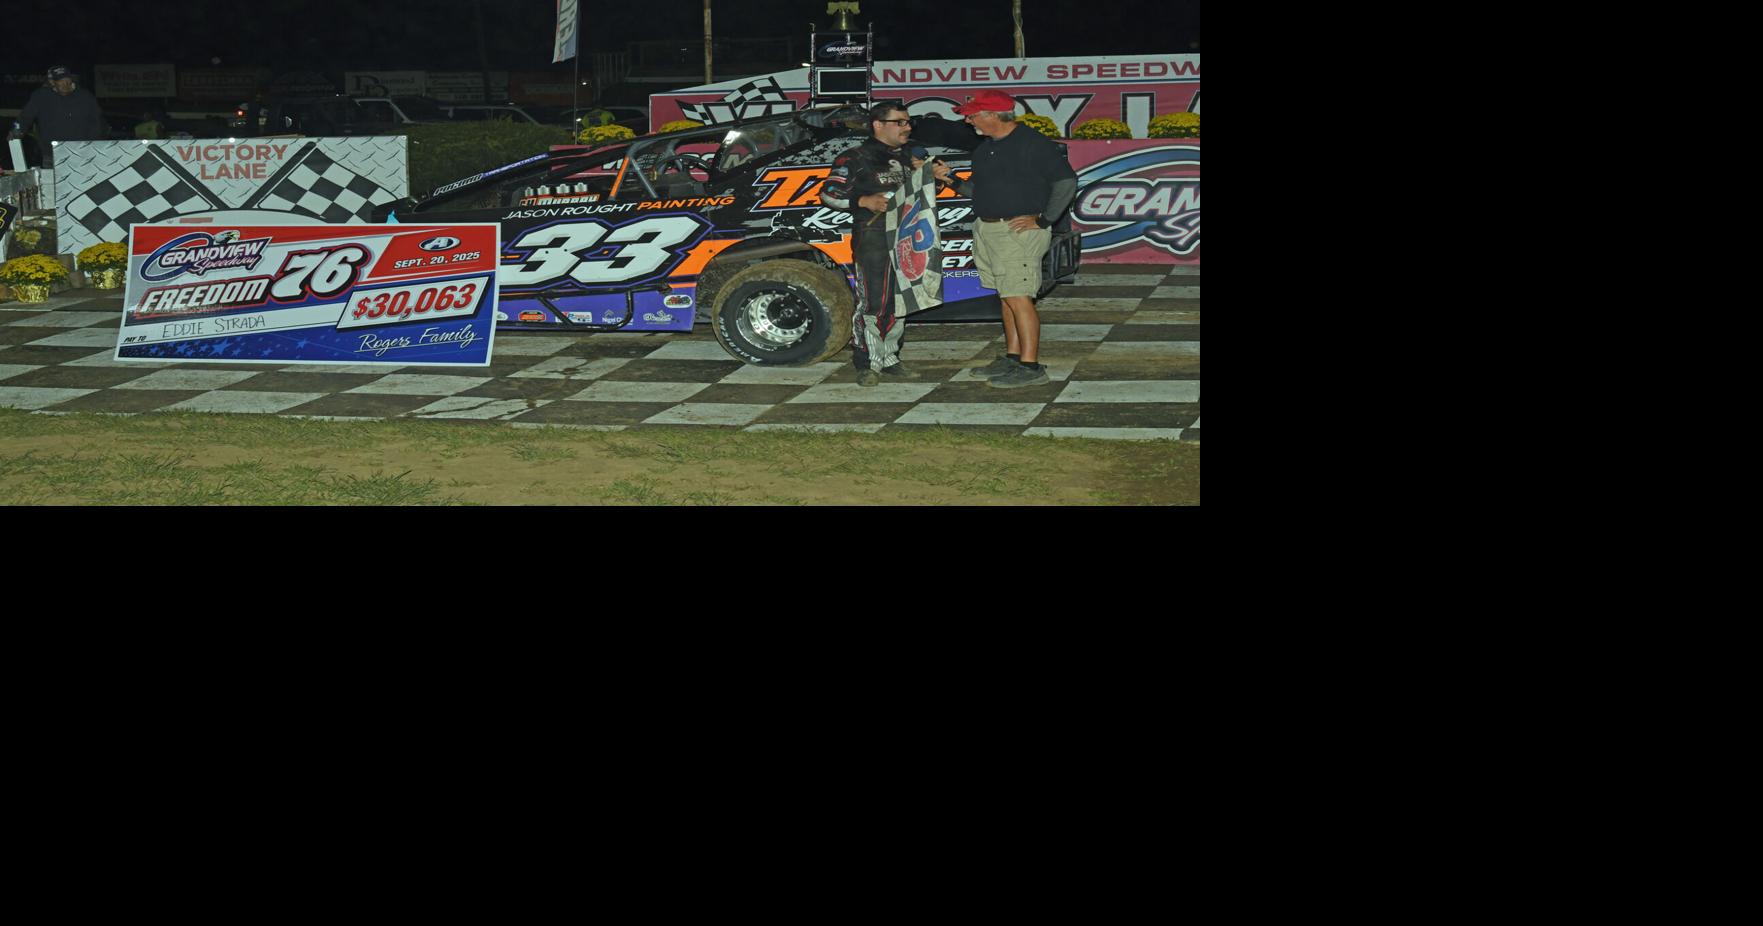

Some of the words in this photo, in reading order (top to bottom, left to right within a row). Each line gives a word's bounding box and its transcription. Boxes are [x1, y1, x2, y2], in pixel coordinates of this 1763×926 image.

[870, 65, 1028, 83] NDVIEW
[176, 144, 288, 161] VICTORY
[200, 162, 268, 180] LANE
[502, 208, 558, 220] JASON
[560, 202, 638, 216] ROUGHT
[637, 196, 736, 211] PAINTING
[161, 241, 265, 266] GRANDVIEW
[394, 258, 427, 269] SEPT.
[451, 251, 480, 262] 2025
[499, 216, 700, 286] 33
[193, 254, 258, 275] Speedway
[139, 278, 270, 313] FREEDOM
[270, 246, 365, 298] 76
[353, 283, 477, 321] $30,063
[162, 321, 205, 339] EDDIE
[214, 315, 266, 333] STRADA
[358, 333, 411, 357] Rogers
[419, 323, 478, 348] Family
